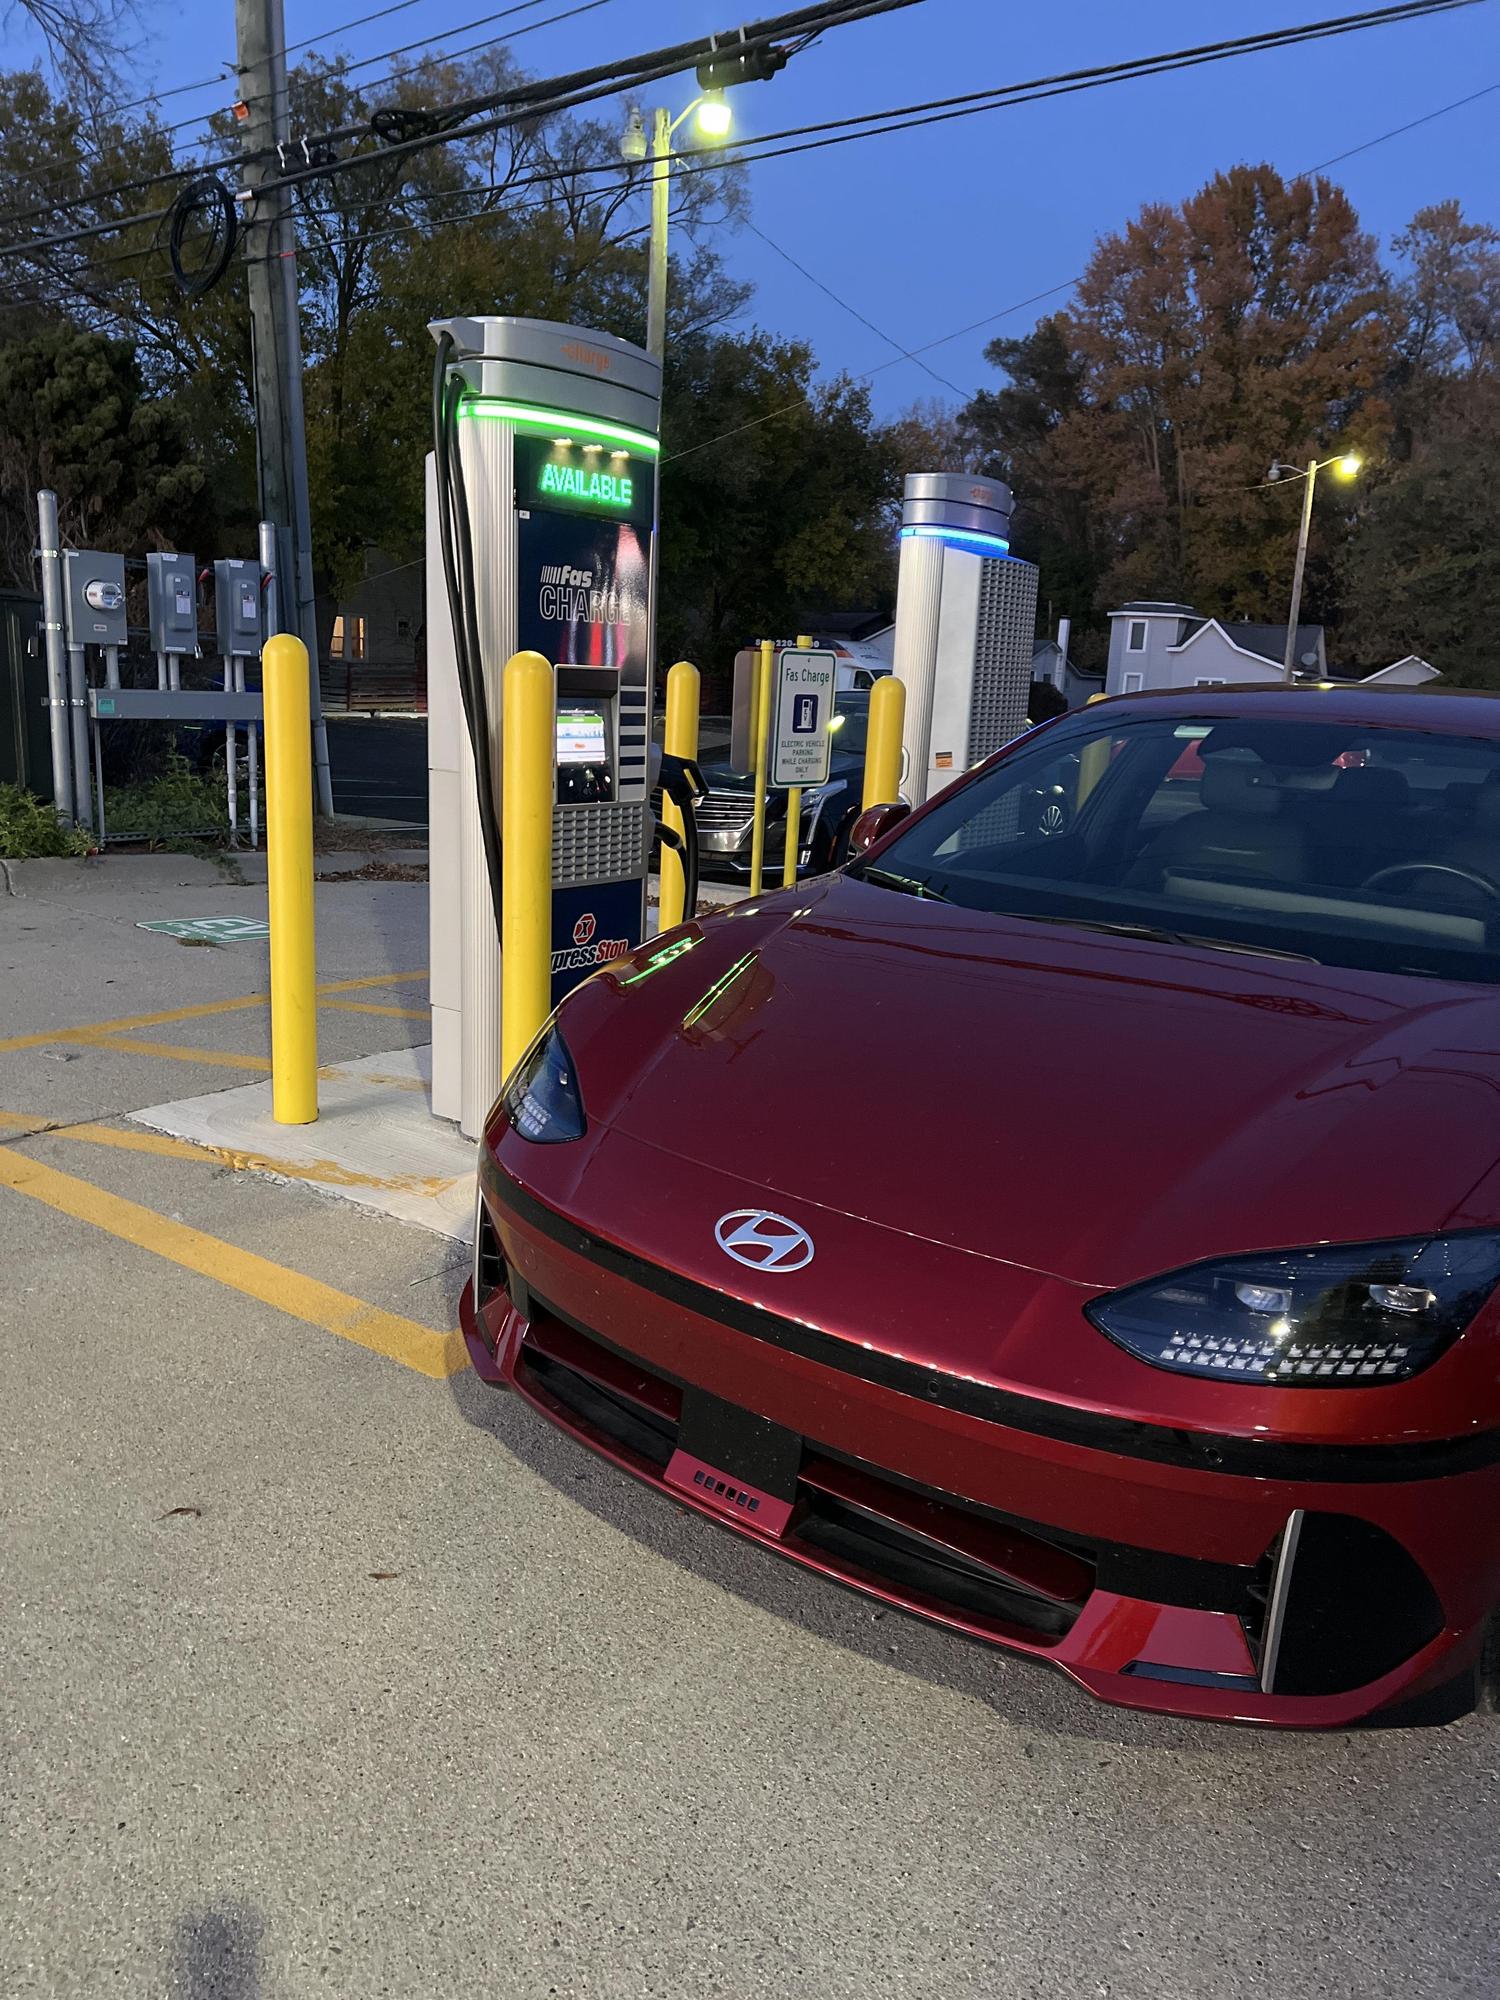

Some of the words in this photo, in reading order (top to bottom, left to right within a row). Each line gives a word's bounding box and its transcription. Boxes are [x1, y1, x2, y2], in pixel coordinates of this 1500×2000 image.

[541, 463, 632, 504] AVAILABLE
[539, 585, 631, 626] CHARGE
[785, 667, 799, 682] Fas
[801, 668, 830, 686] Charge
[781, 740, 804, 748] ELECTRIC
[805, 740, 825, 748] VEHICLE
[798, 757, 823, 765] CHARGING
[795, 766, 809, 774] ONLY
